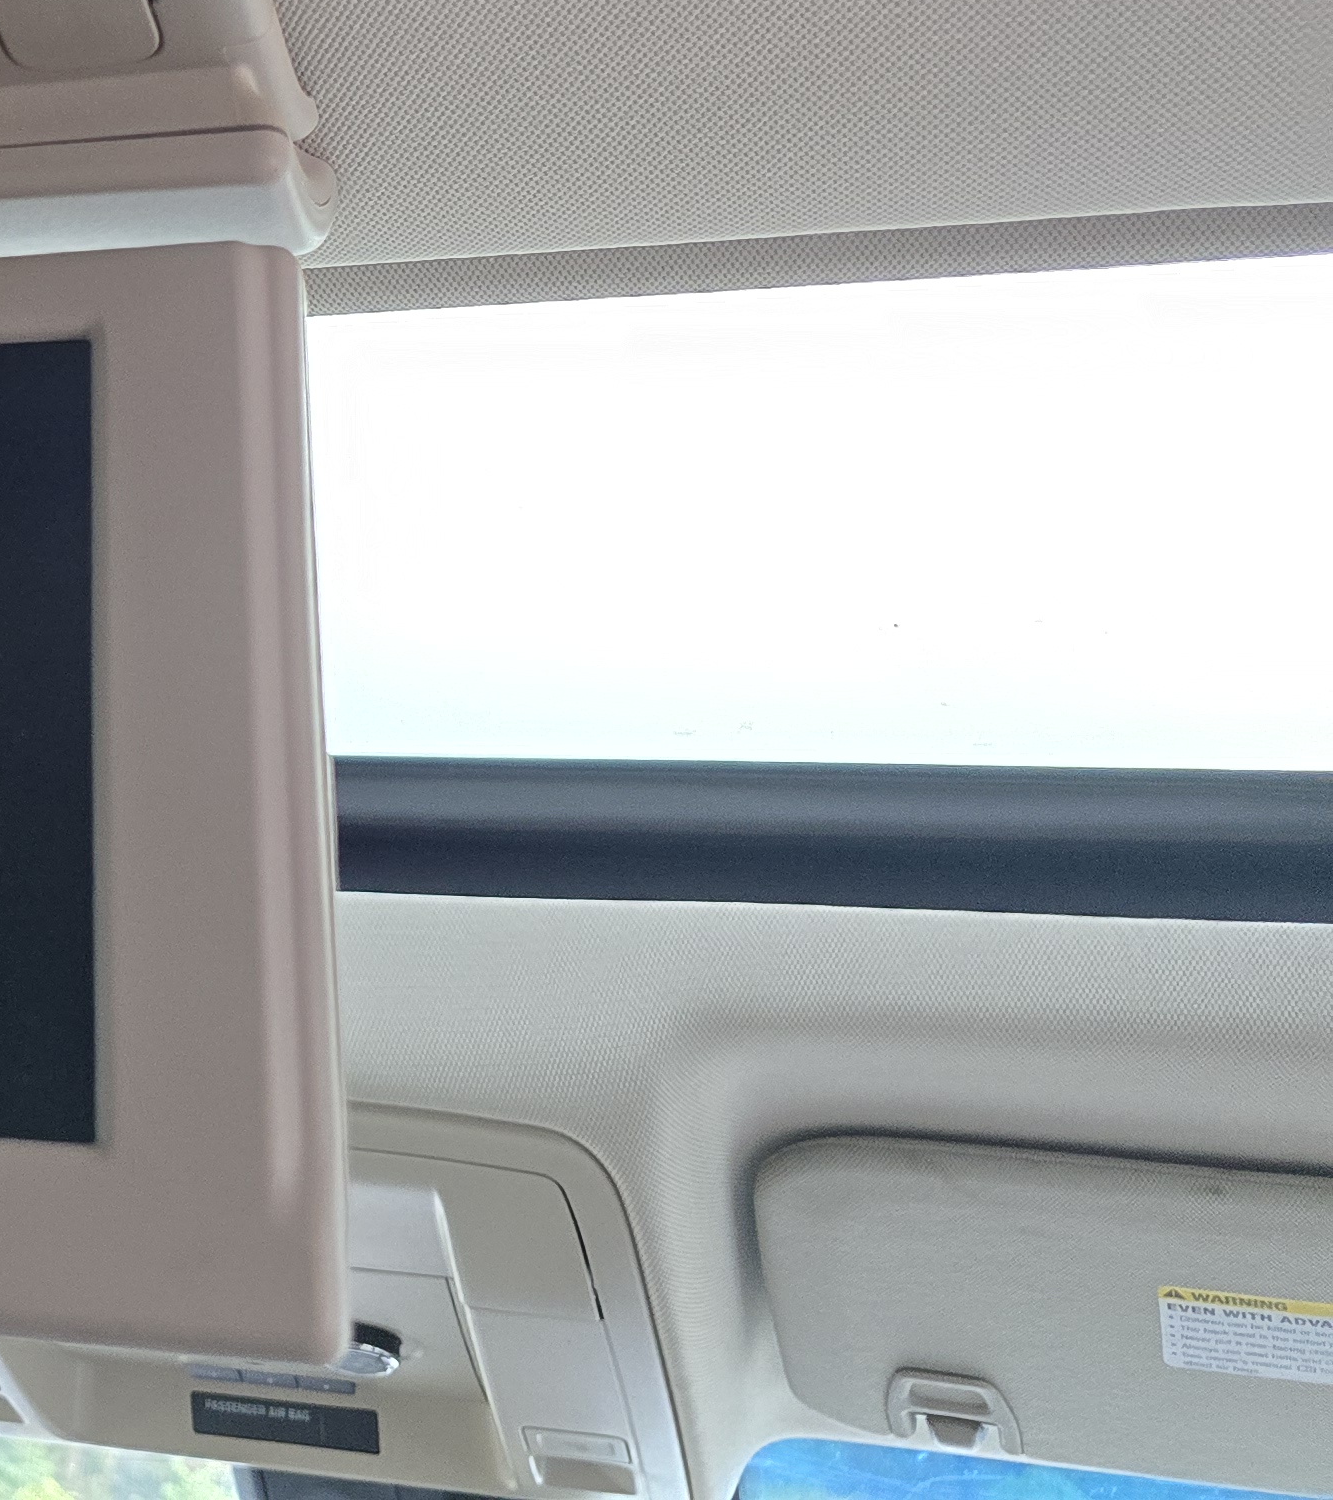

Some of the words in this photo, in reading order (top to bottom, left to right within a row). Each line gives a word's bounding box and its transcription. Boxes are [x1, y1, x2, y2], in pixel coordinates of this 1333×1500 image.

[1191, 1292, 1288, 1312] WARNING
[1166, 1302, 1216, 1316] EVEN
[1222, 1309, 1273, 1323] WITH
[204, 1398, 267, 1416] PASSENGER
